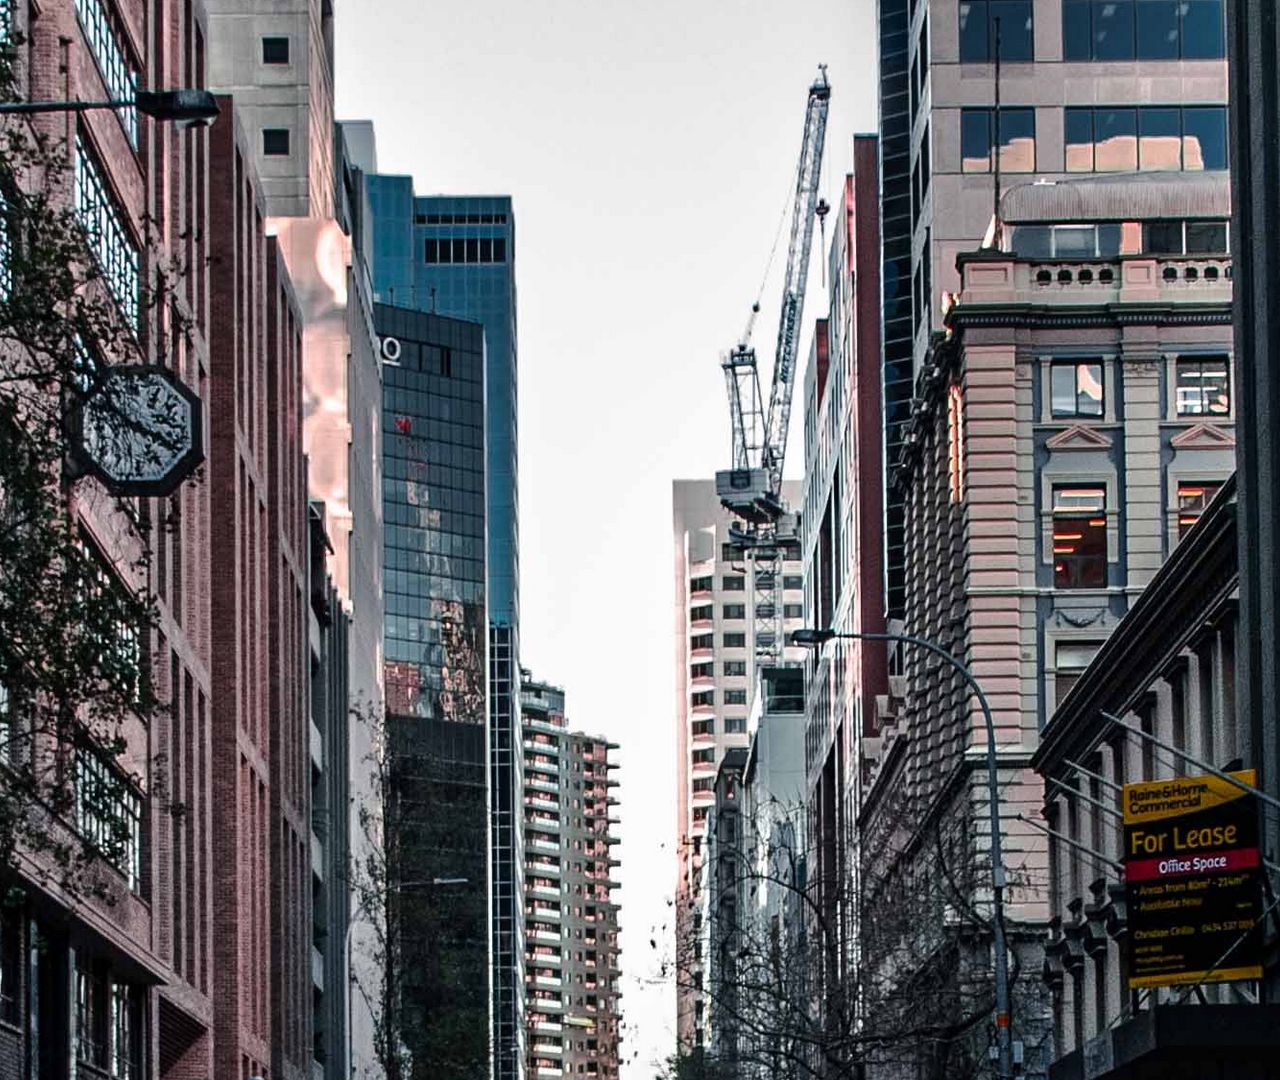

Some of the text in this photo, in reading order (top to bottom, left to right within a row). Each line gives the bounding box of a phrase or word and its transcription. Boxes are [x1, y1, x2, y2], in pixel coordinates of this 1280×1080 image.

[1129, 797, 1201, 814] Commercial
[1130, 824, 1238, 855] For Lease
[1158, 856, 1227, 874] Office Space
